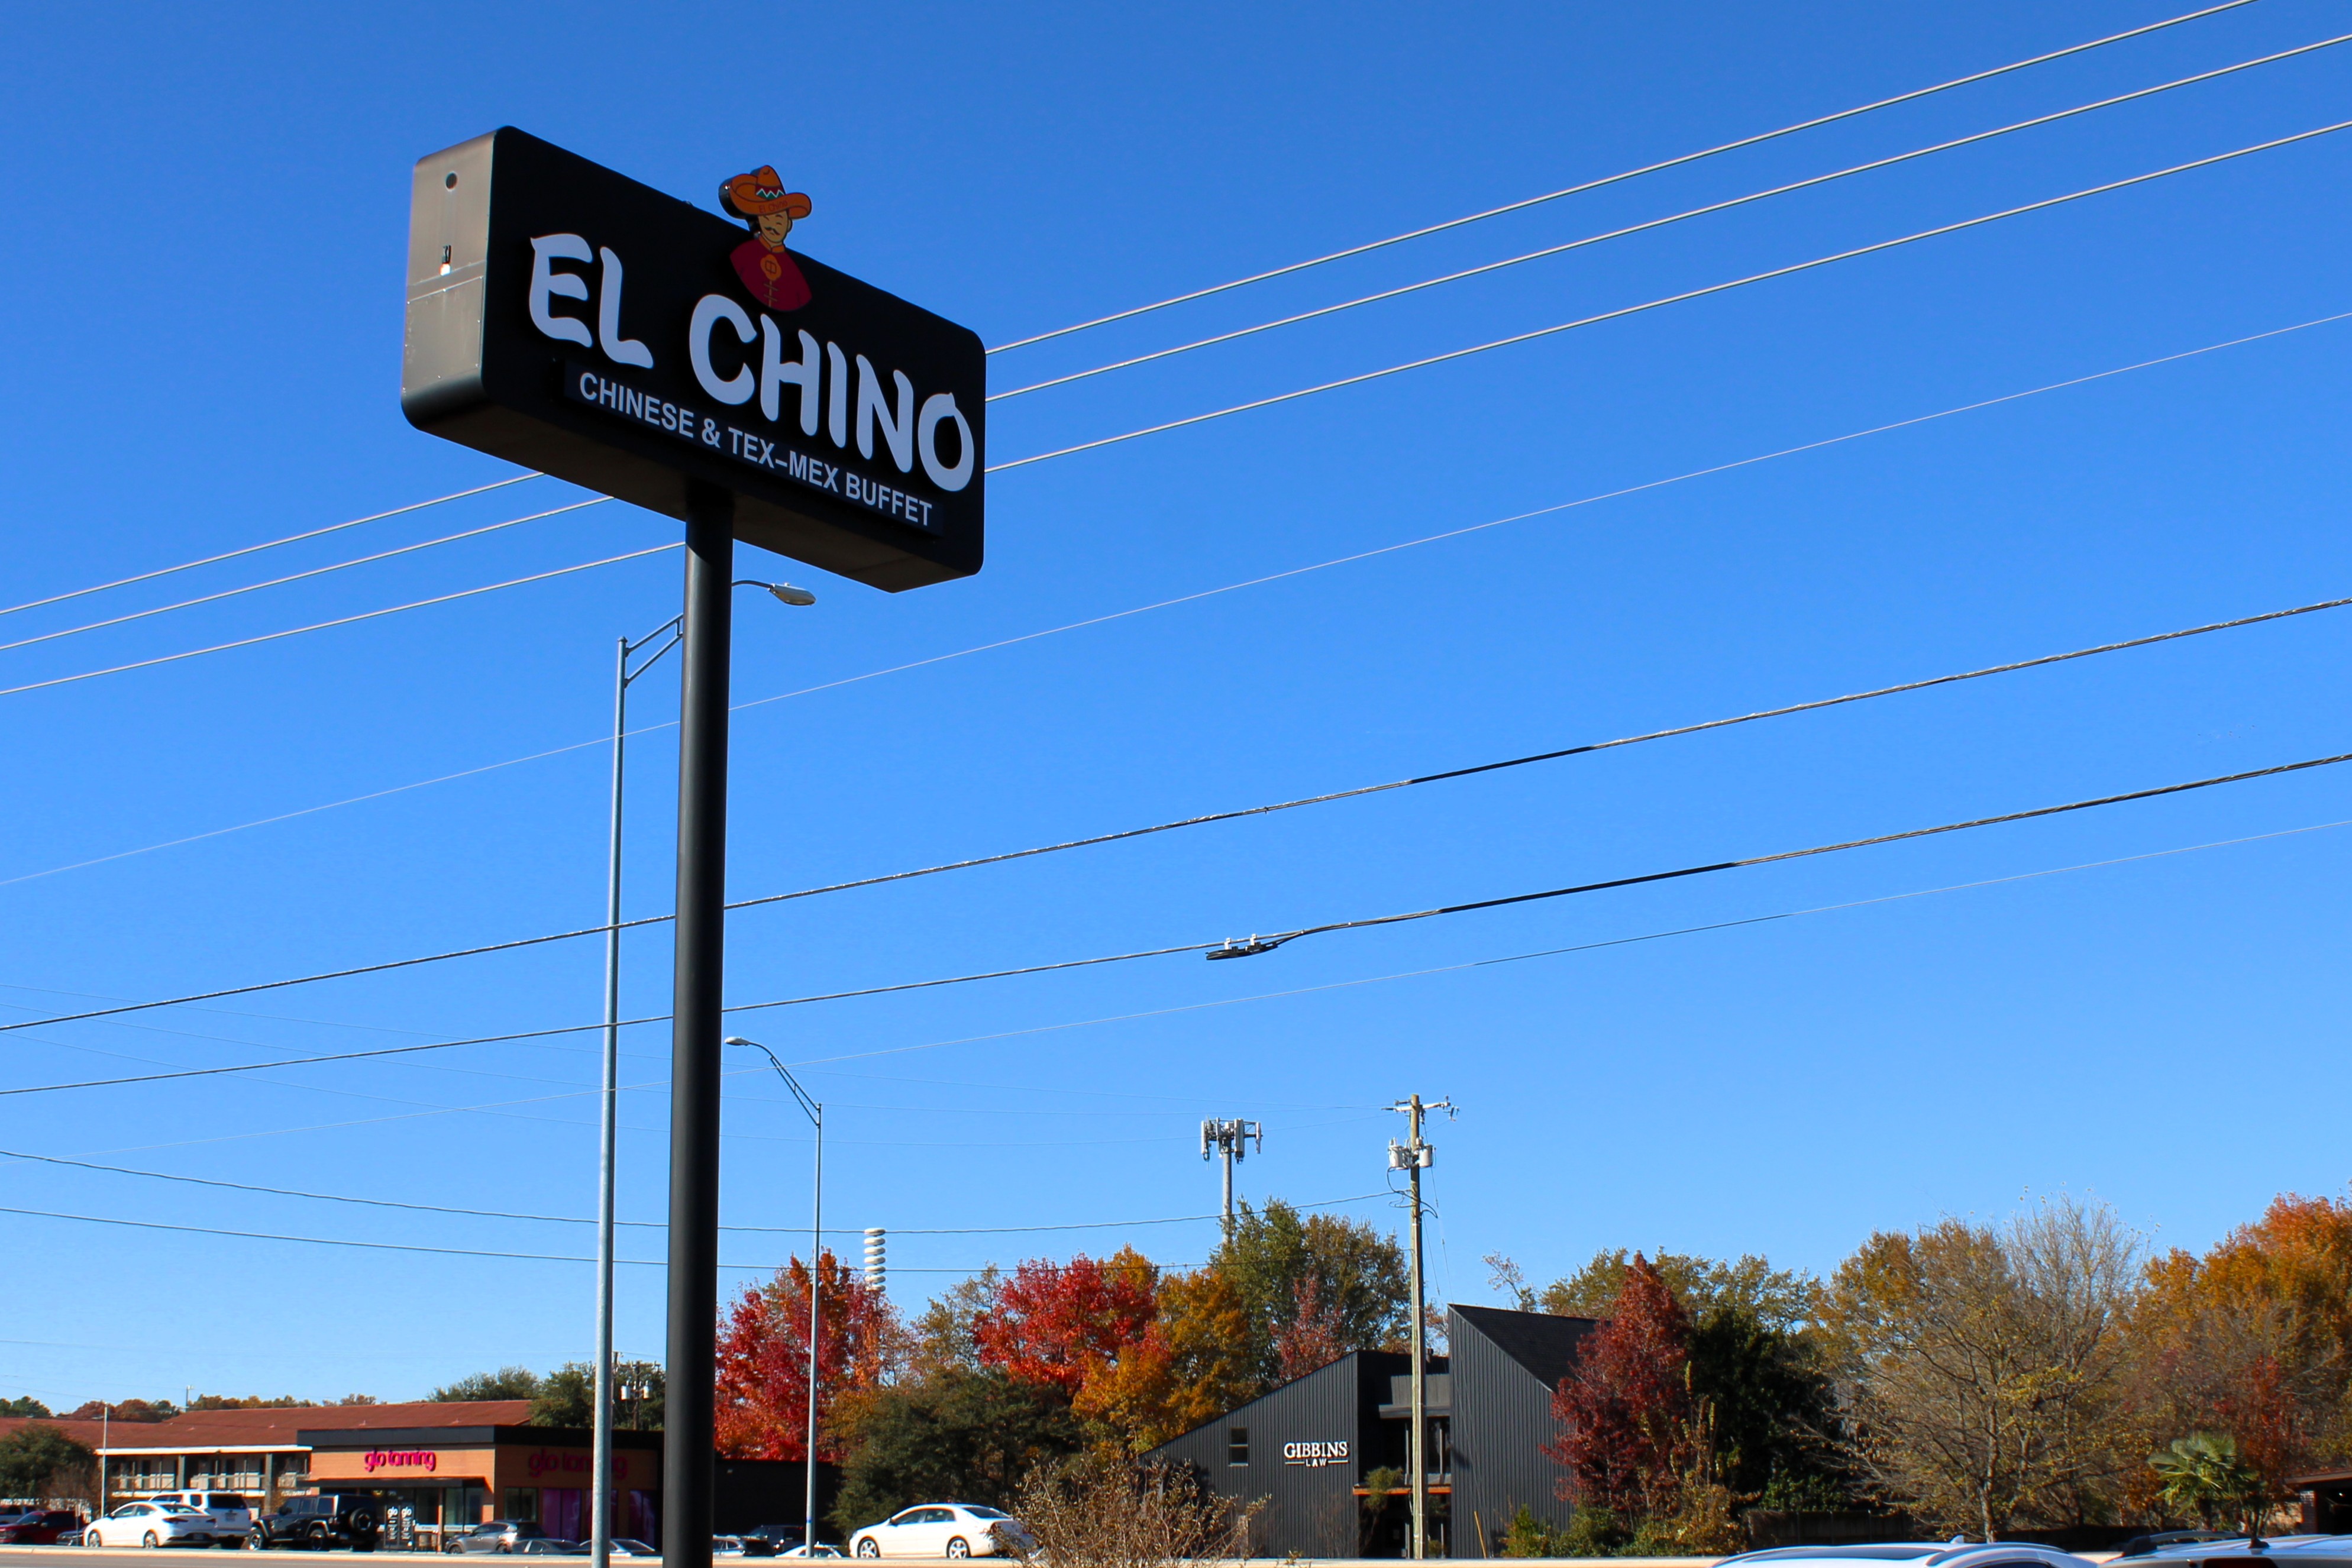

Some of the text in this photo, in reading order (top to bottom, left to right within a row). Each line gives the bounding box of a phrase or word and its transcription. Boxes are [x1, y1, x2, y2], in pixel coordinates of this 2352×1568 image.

[529, 233, 974, 491] EL CHINO
[580, 372, 932, 526] CHINESE & TEX-MEX BUFFET
[364, 1448, 436, 1472] glo tanning
[529, 1447, 627, 1479] glo tang
[1284, 1441, 1348, 1459] GIBBINS
[1306, 1459, 1327, 1467] LAW
